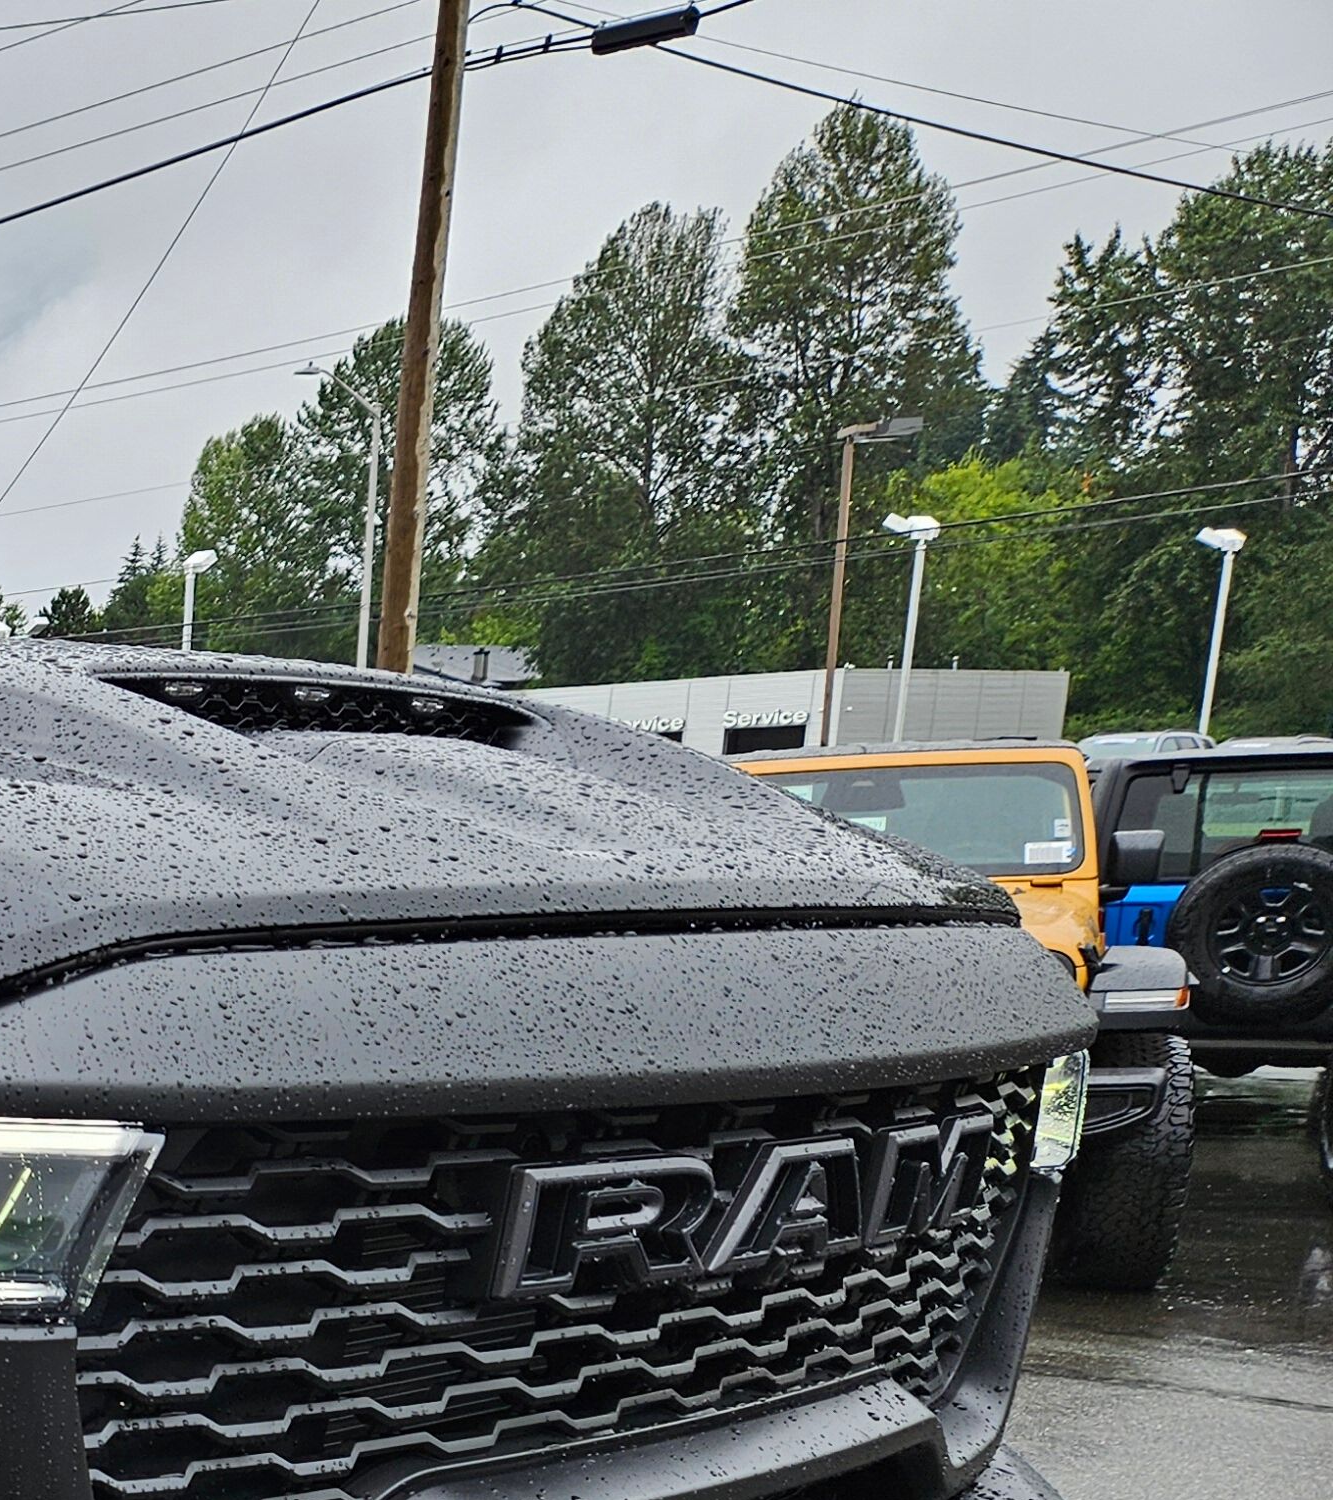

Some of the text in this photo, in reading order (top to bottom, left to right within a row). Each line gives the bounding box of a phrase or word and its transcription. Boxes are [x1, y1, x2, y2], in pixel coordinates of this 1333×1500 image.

[609, 715, 685, 732] rvice
[721, 708, 809, 728] Service
[490, 1110, 994, 1300] RAM
